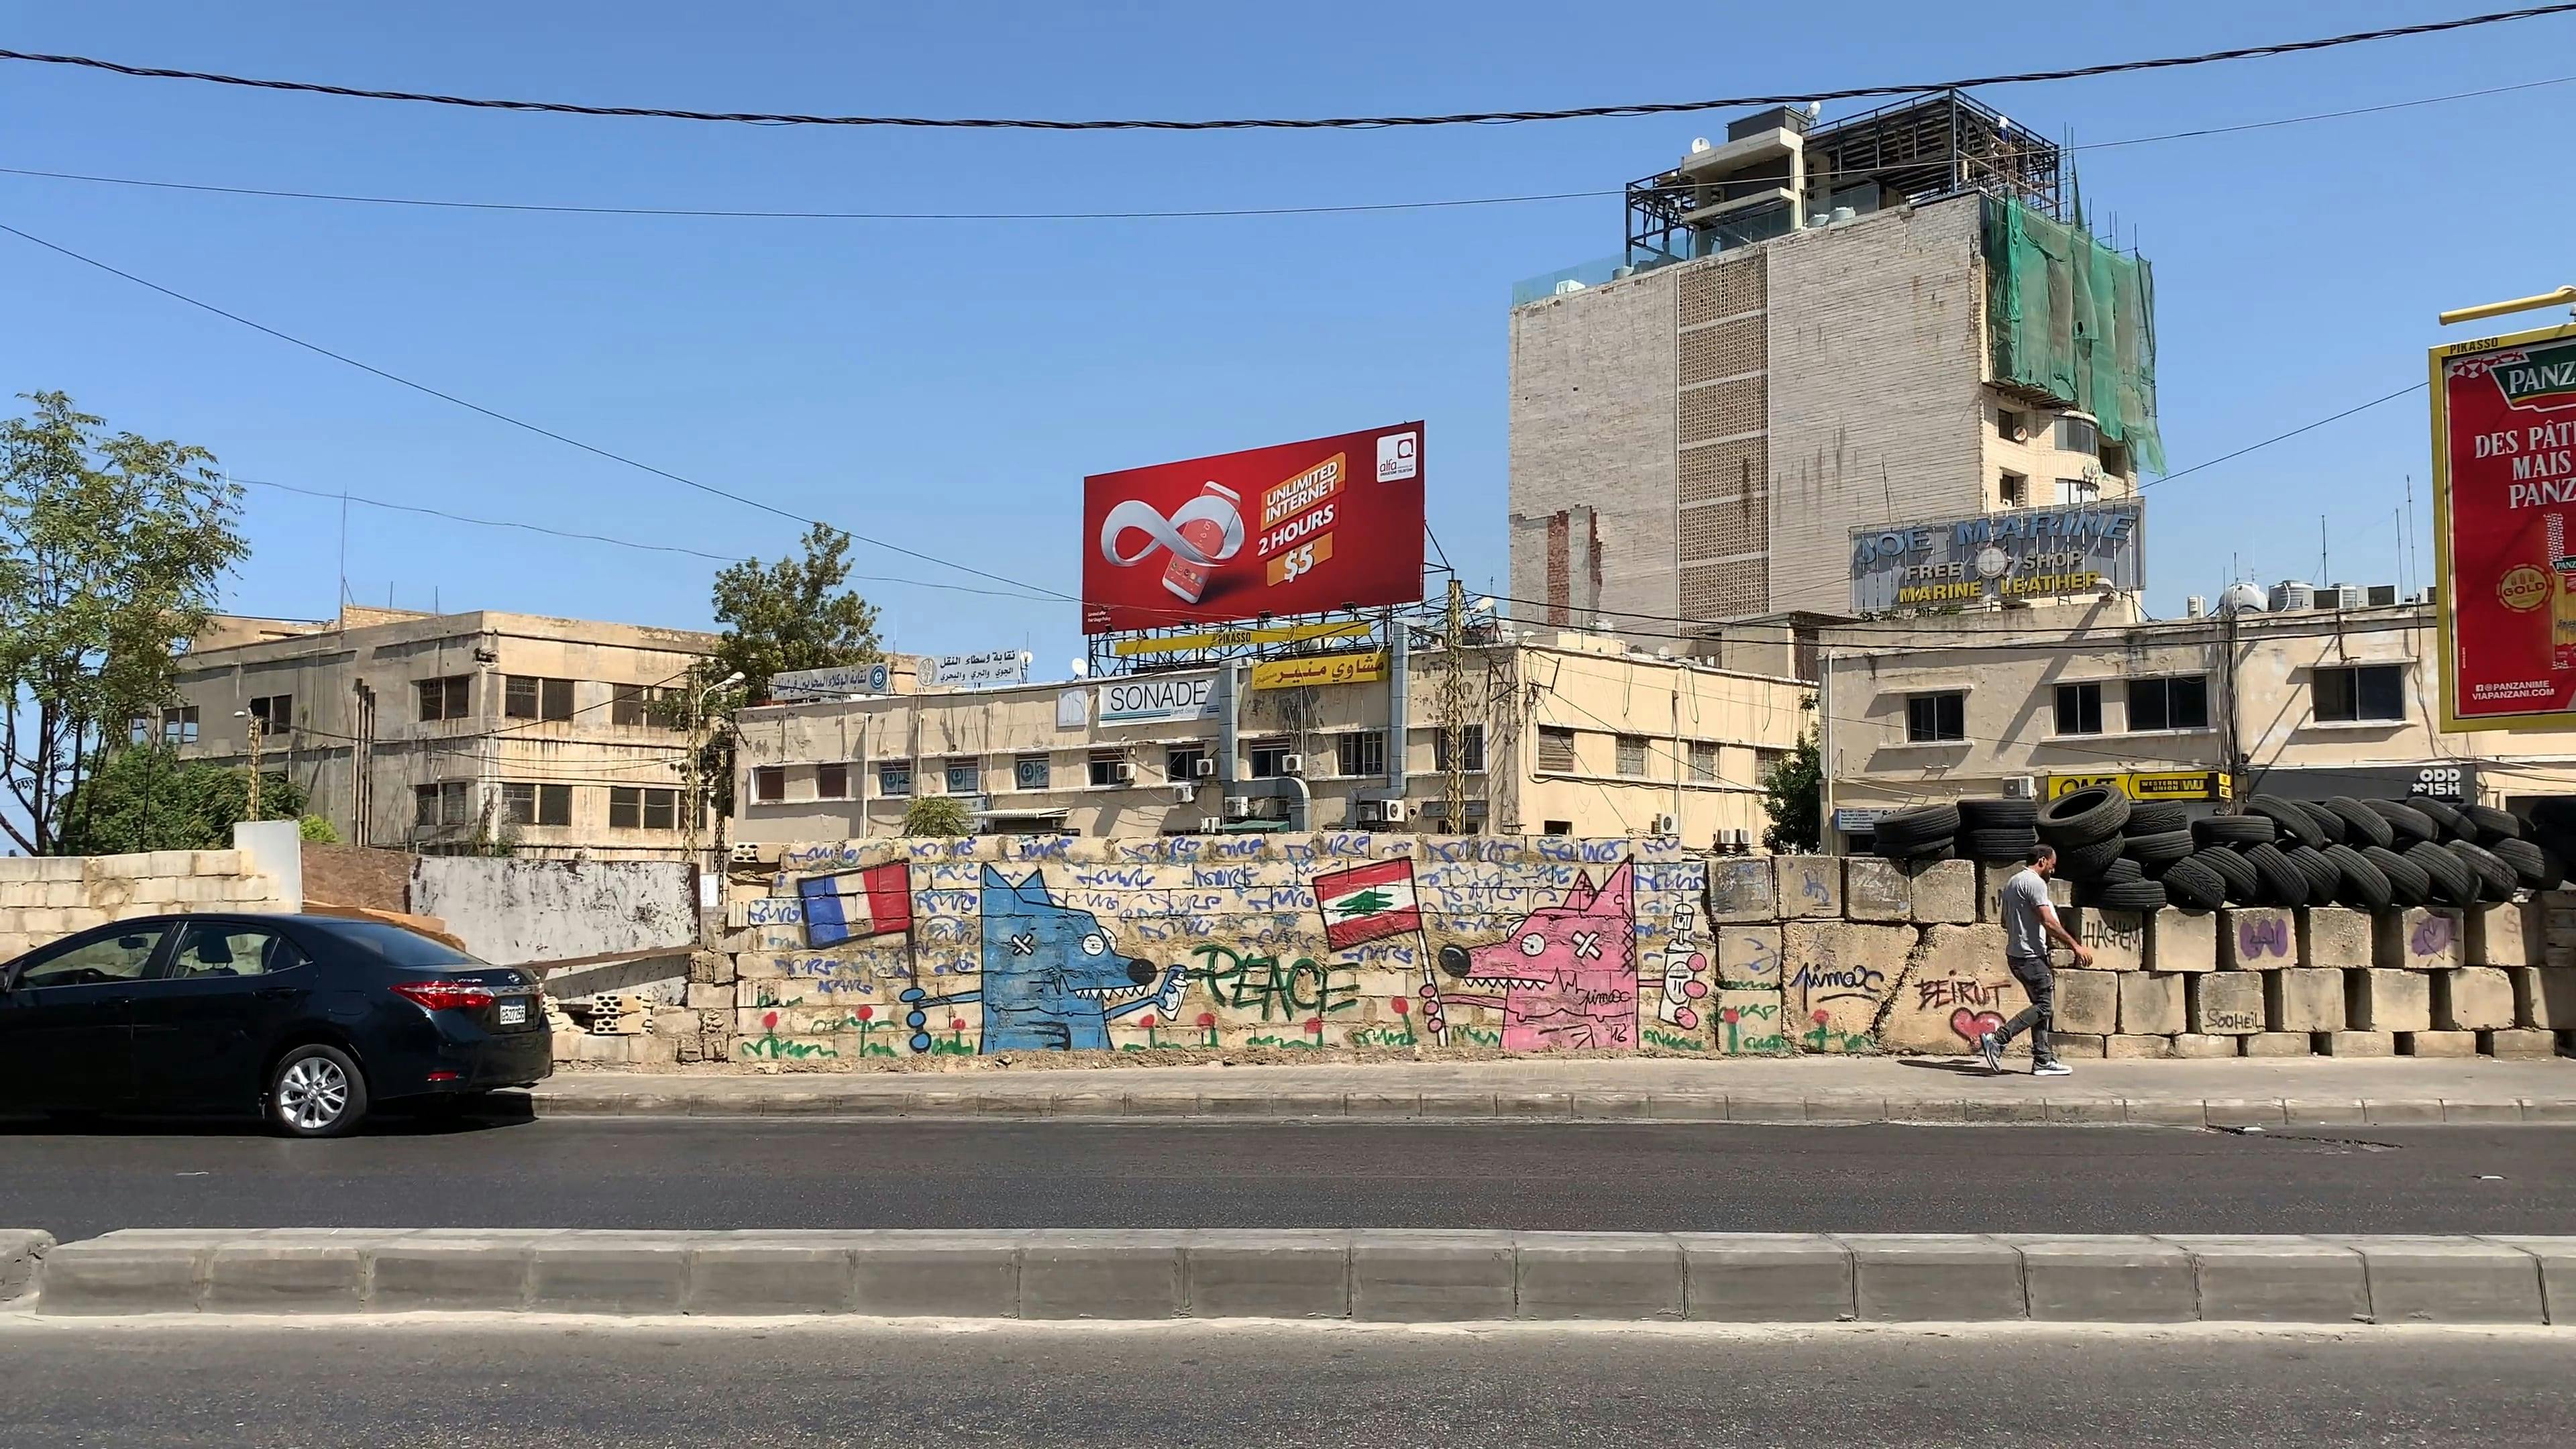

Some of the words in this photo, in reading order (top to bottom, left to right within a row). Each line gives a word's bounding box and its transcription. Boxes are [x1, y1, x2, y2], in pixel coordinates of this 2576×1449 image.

[2450, 337, 2499, 354] PIKASSO
[2475, 430, 2519, 459] DES
[2528, 419, 2576, 451] PÂT
[1380, 458, 1397, 472] alfa
[2512, 450, 2571, 480] MAIS
[1267, 461, 1338, 506] UNLIMITED
[1266, 475, 1338, 524] INTERNET
[1257, 537, 1269, 557] 2
[1271, 504, 1334, 550] HOURS
[1858, 526, 1933, 564] JOE
[1956, 512, 2139, 545] MARINE
[1284, 543, 1314, 583] $5
[1907, 561, 1962, 580] FREE
[2024, 549, 2084, 570] SHOP
[1898, 580, 1983, 603] MARINE
[2000, 571, 2101, 595] LEATHER
[2504, 582, 2545, 596] GOLD
[1218, 632, 1251, 645] PIKASSO
[940, 656, 961, 668] النقل
[965, 653, 990, 665] وسطاء
[992, 650, 1015, 664] نقابة
[1332, 655, 1385, 682] مشاوي
[1275, 661, 1326, 683] منير
[2472, 688, 2555, 700] VIAPANZANI.COM
[2183, 780, 2204, 790] WU
[2419, 769, 2461, 782] ODD
[1191, 944, 1360, 1021] PEACE
[1914, 970, 2011, 1011] BEIRUT
